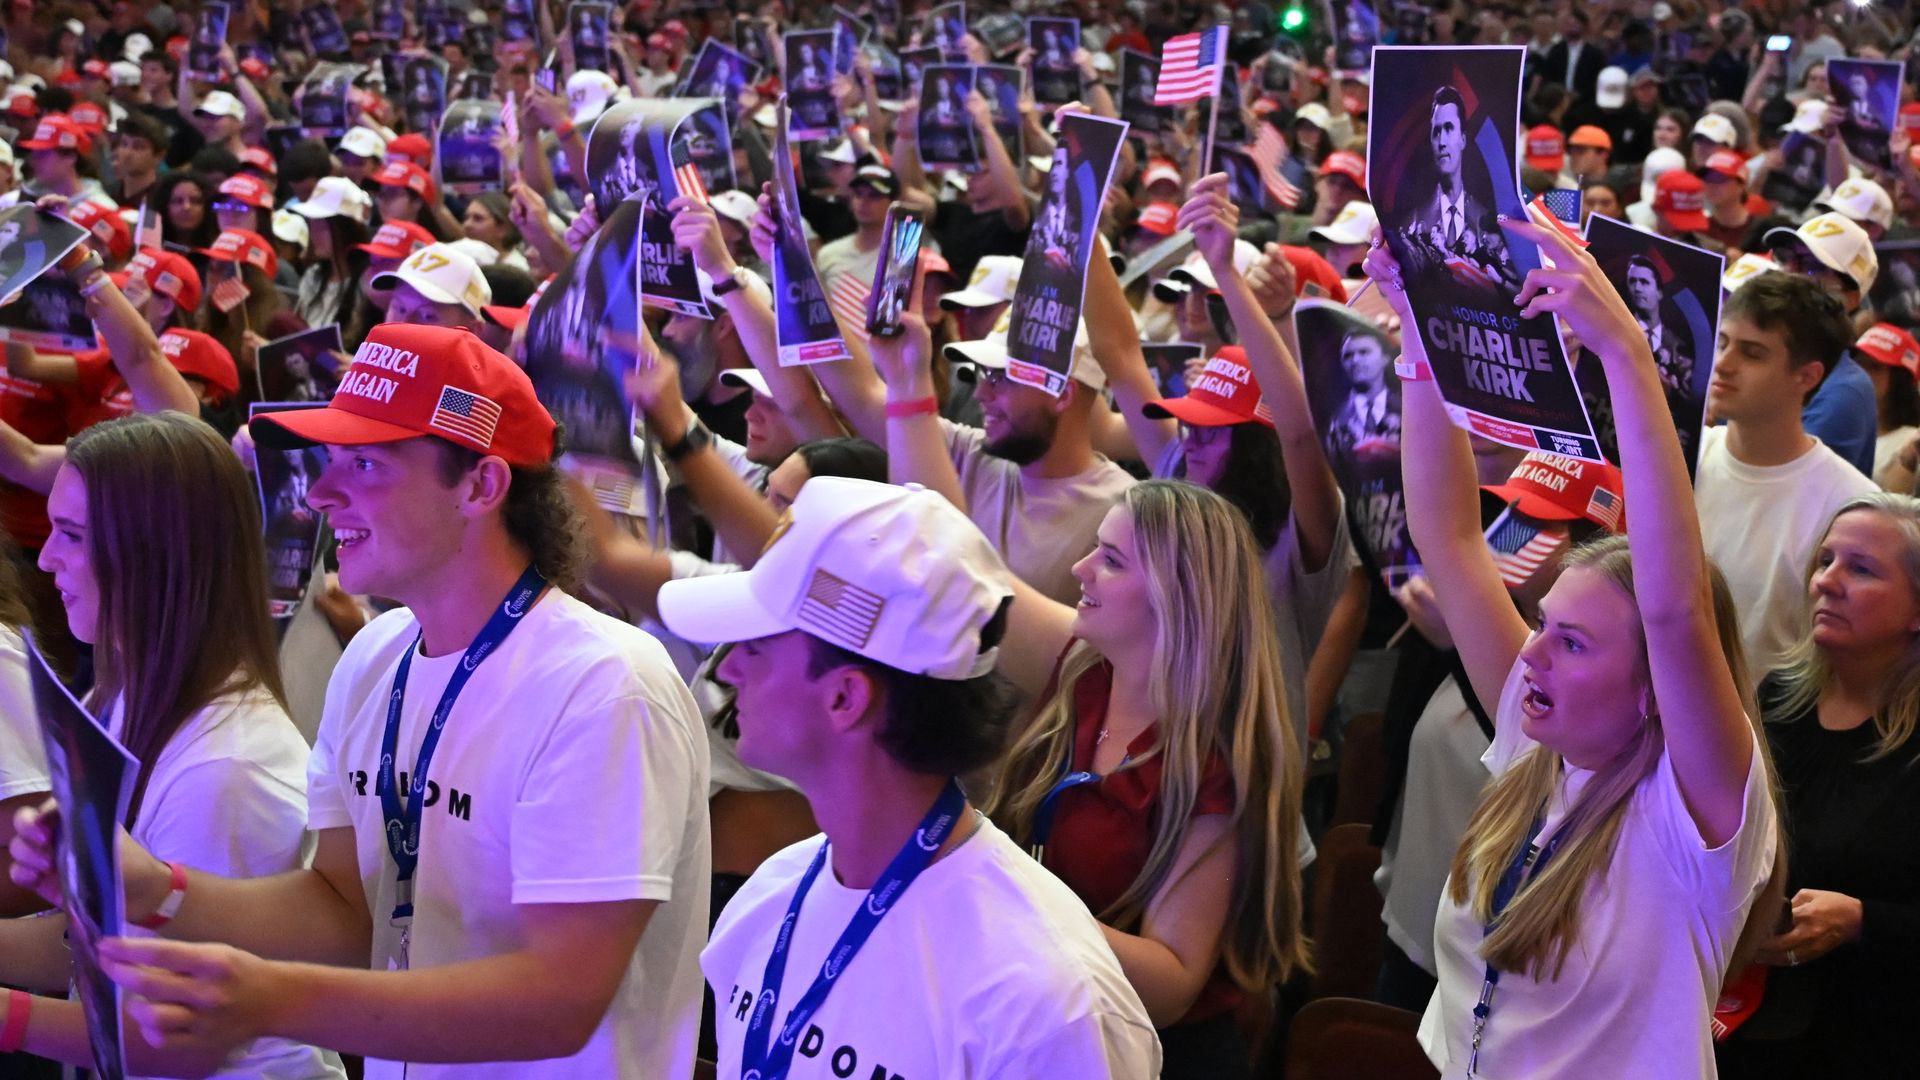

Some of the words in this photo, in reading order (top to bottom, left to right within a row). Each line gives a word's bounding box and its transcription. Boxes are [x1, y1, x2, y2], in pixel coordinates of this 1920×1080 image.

[1451, 306, 1499, 328] HONOR
[1501, 315, 1520, 331] OF
[1018, 320, 1061, 353] KIRK
[1427, 316, 1553, 373] CHARLIE
[342, 371, 399, 404] AGAIN
[1202, 374, 1238, 399] AGAIN
[1463, 357, 1535, 403] KIRK
[1524, 465, 1570, 493] AGAIN
